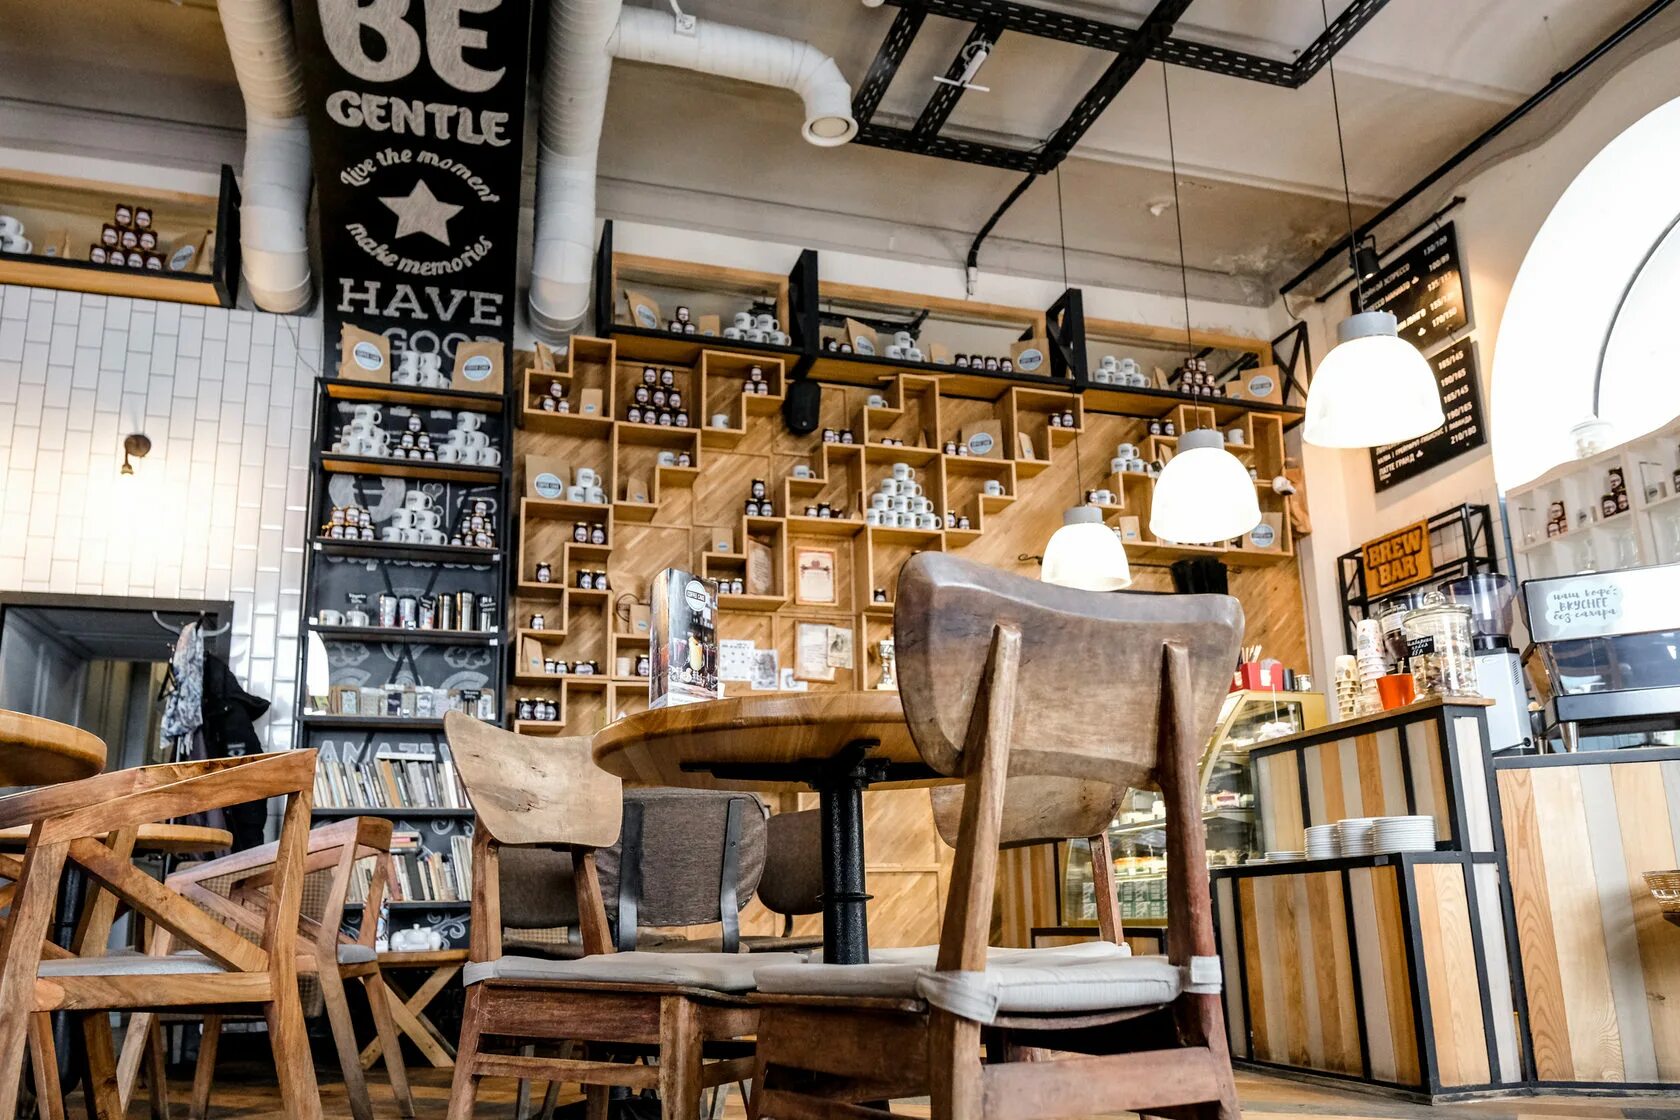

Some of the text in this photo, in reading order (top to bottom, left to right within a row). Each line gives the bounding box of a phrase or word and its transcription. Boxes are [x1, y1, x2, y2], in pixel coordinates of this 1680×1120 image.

[317, 0, 507, 93] BE
[325, 90, 511, 147] GENTLE
[340, 147, 500, 203] Live the moment
[345, 223, 493, 276] make memories
[337, 277, 503, 326] HAVE
[381, 327, 500, 360] GOO
[1367, 526, 1422, 570] BREW
[1378, 554, 1418, 587] BAR
[1553, 592, 1580, 601] наш
[1553, 608, 1616, 623] без сахара
